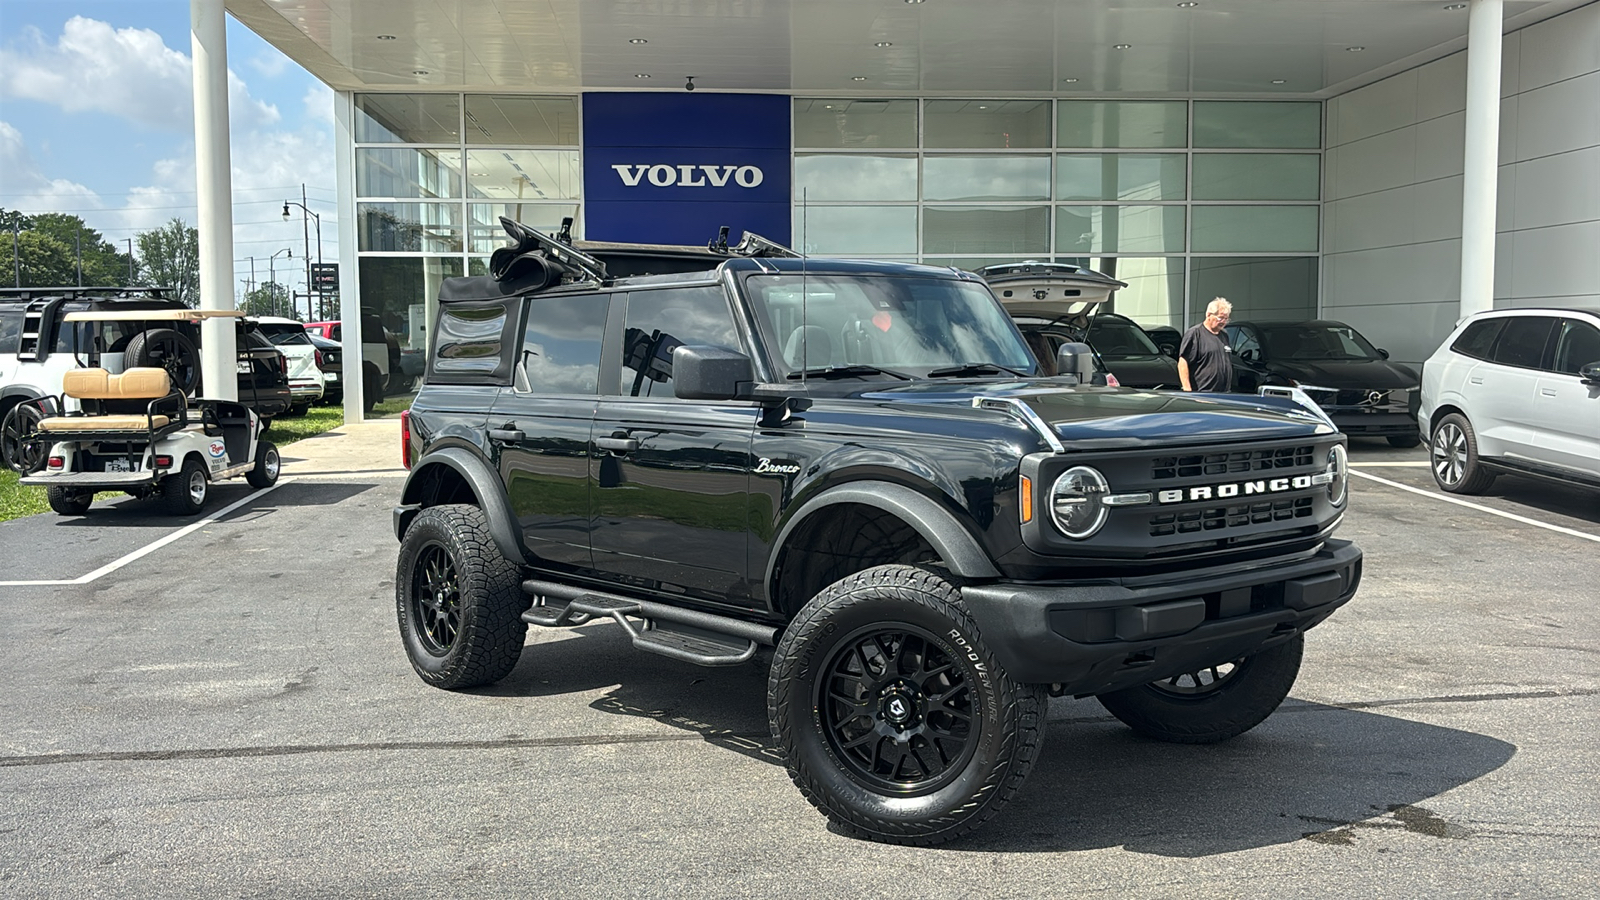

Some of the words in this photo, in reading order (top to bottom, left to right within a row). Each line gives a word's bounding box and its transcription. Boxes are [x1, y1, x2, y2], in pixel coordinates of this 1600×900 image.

[611, 164, 764, 188] VOLVO
[753, 457, 801, 473] Bronco
[1158, 475, 1311, 504] BRONCO
[794, 621, 838, 682] KUMHO
[946, 628, 999, 726] ROADVENTURE
